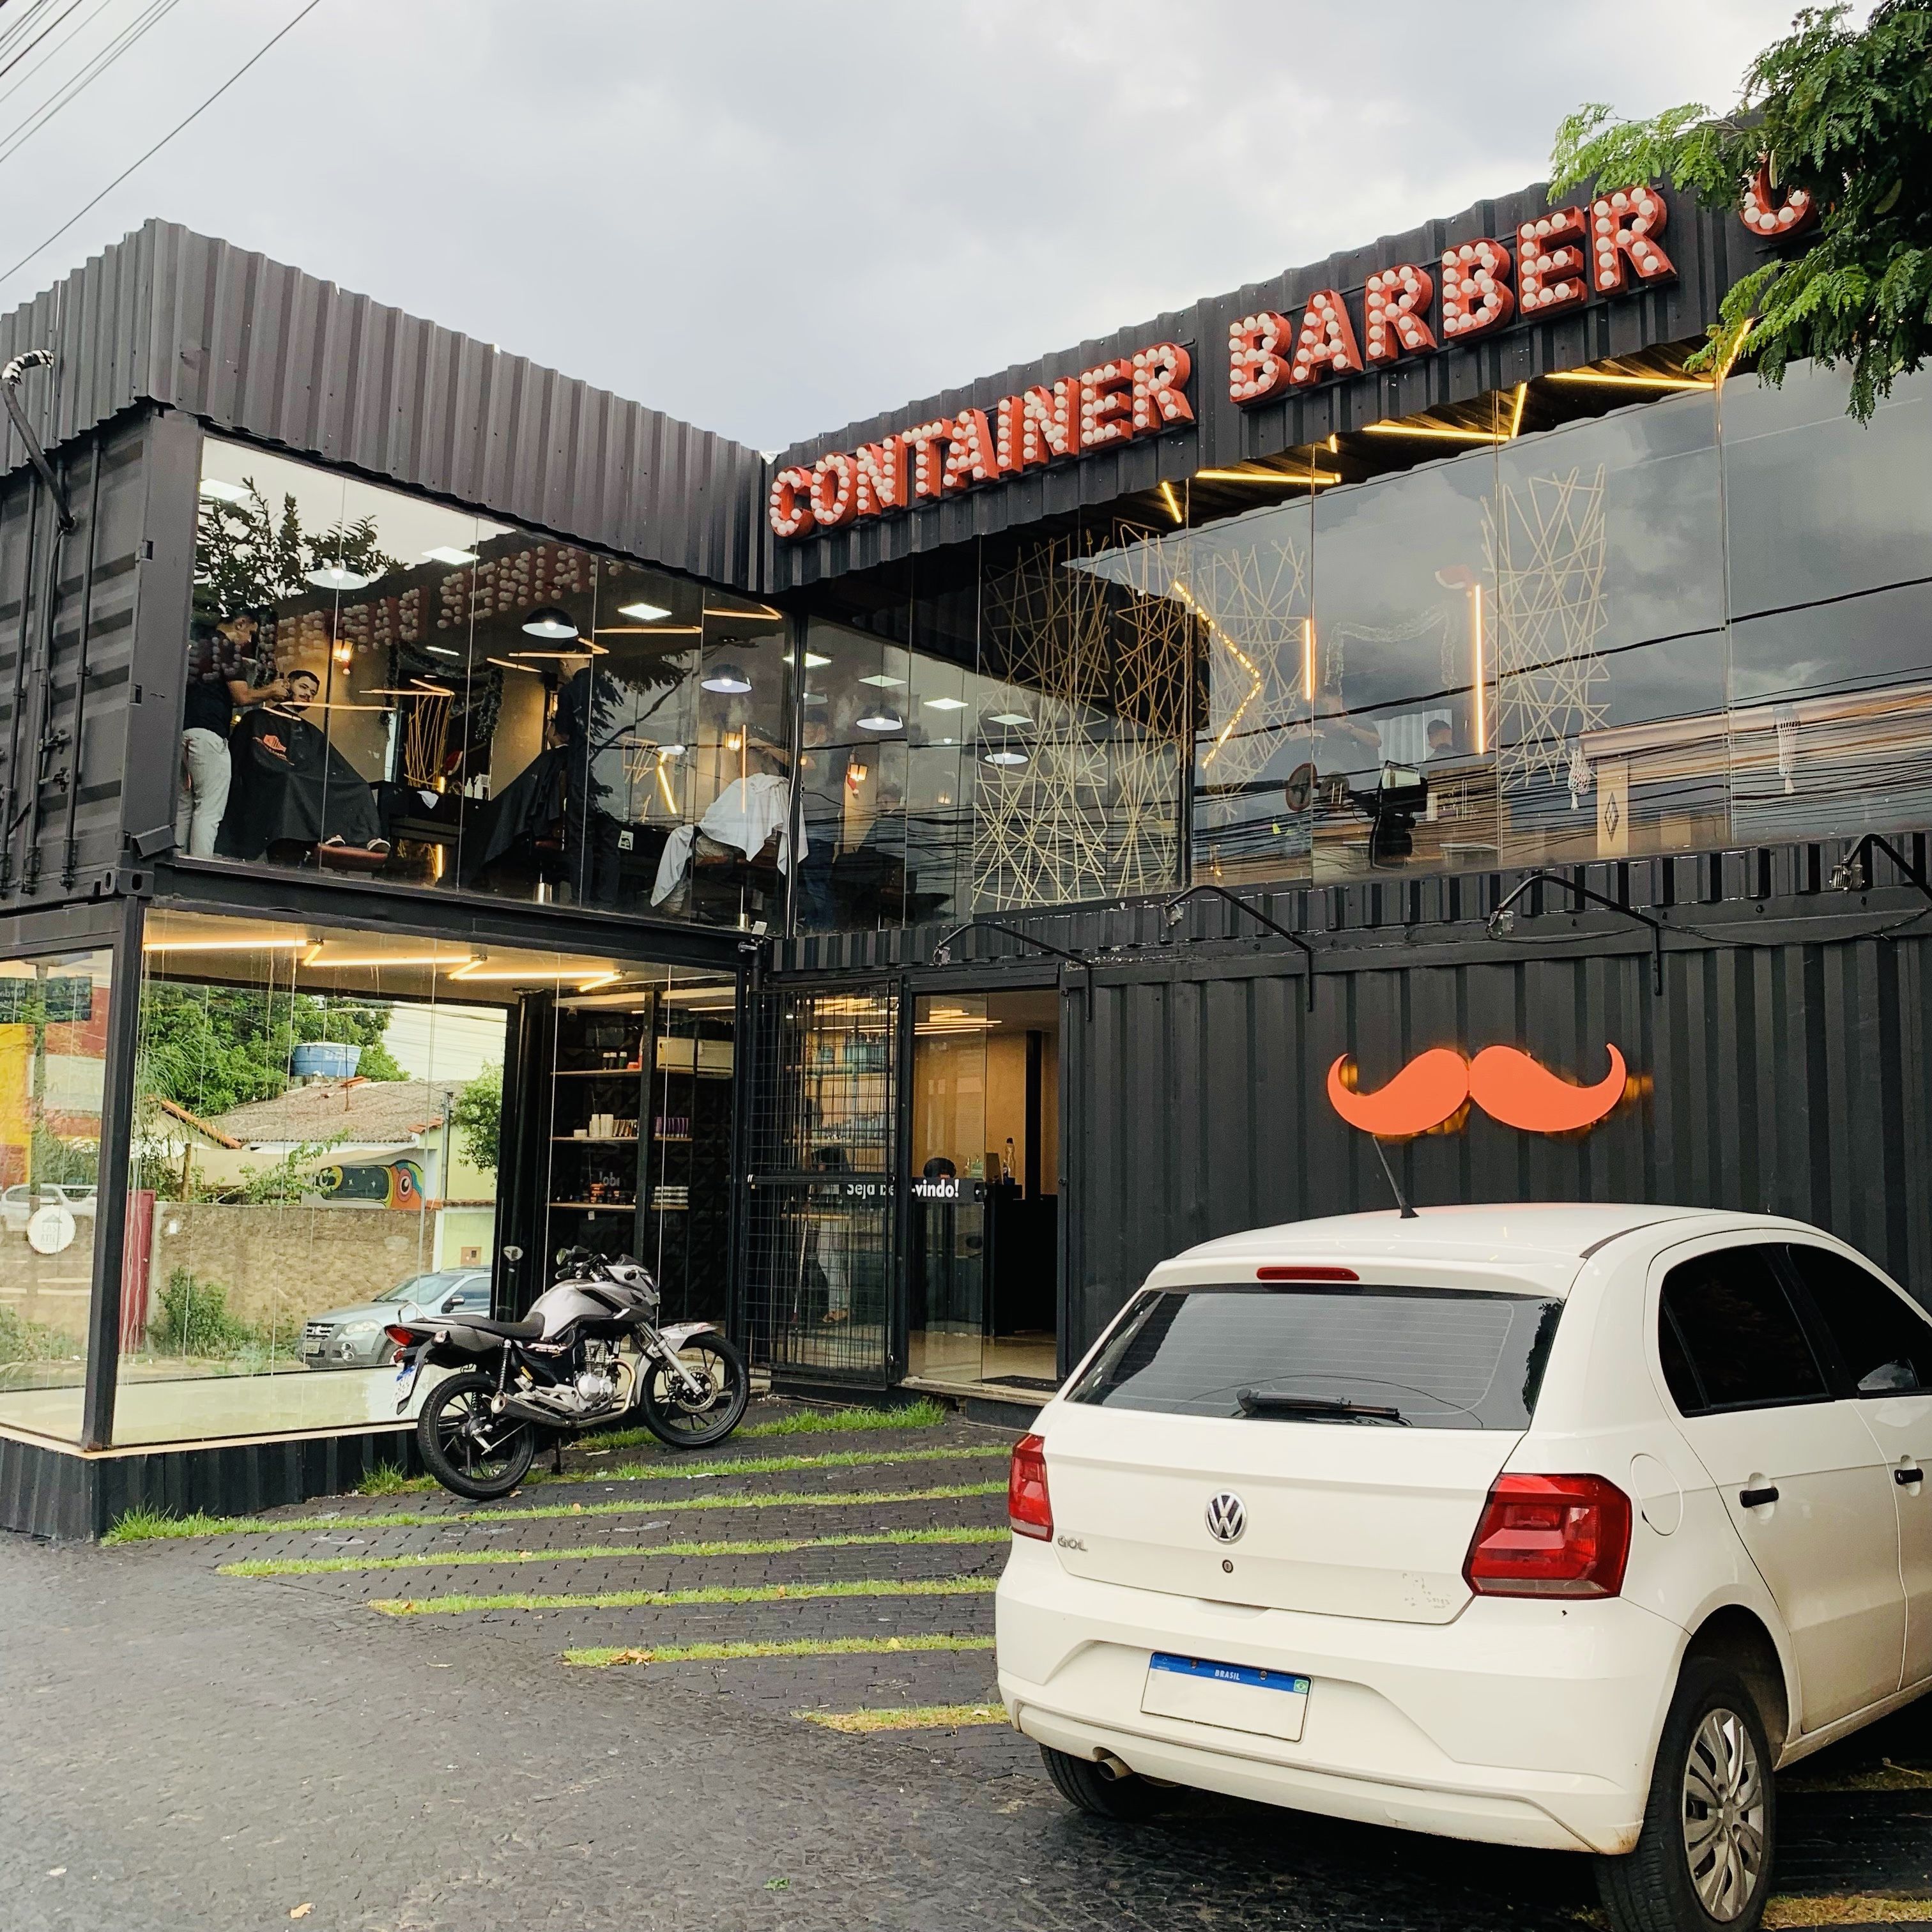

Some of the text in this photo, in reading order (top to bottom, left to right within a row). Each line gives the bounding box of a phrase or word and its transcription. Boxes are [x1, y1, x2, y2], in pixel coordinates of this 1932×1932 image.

[770, 343, 1195, 538] CONTAINER
[1229, 186, 1676, 406] BARBER
[1057, 1535, 1088, 1552] GOL
[1215, 1669, 1240, 1680] BRASIL
